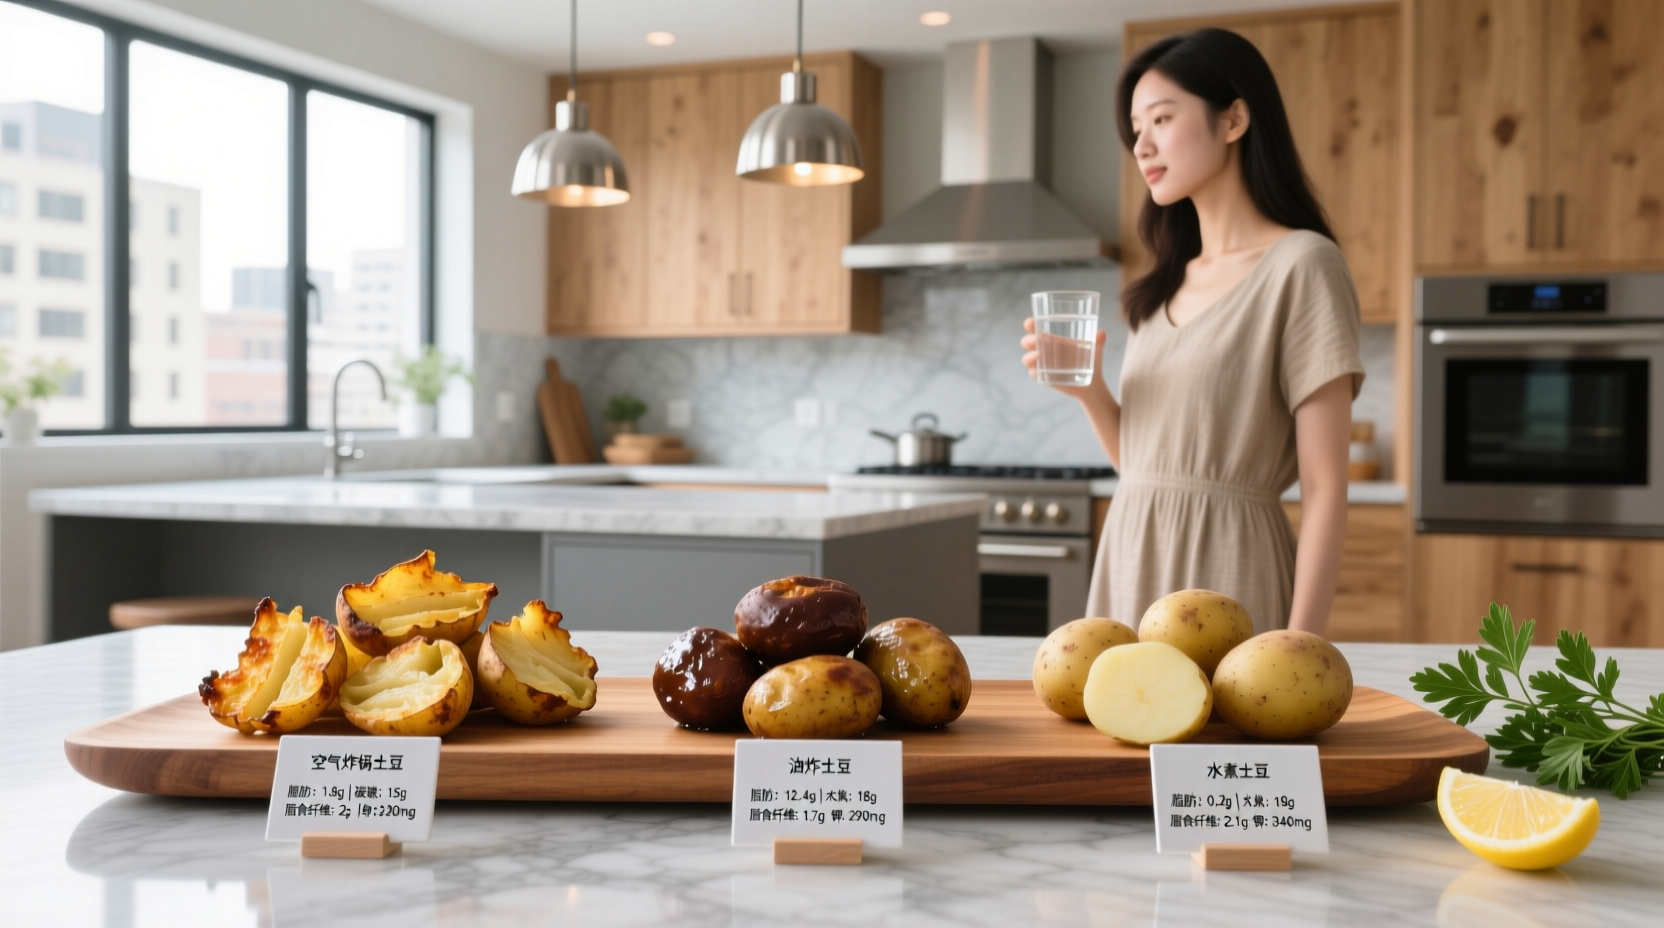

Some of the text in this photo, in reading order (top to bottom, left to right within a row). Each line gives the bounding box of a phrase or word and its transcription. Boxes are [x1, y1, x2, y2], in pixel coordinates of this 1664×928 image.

[311, 754, 403, 771] 空气炸锅土豆
[789, 757, 851, 775] 油炸土豆
[1207, 762, 1270, 779] 水煮土豆
[786, 790, 816, 803] 12.4g
[1272, 816, 1311, 831] 340mg
